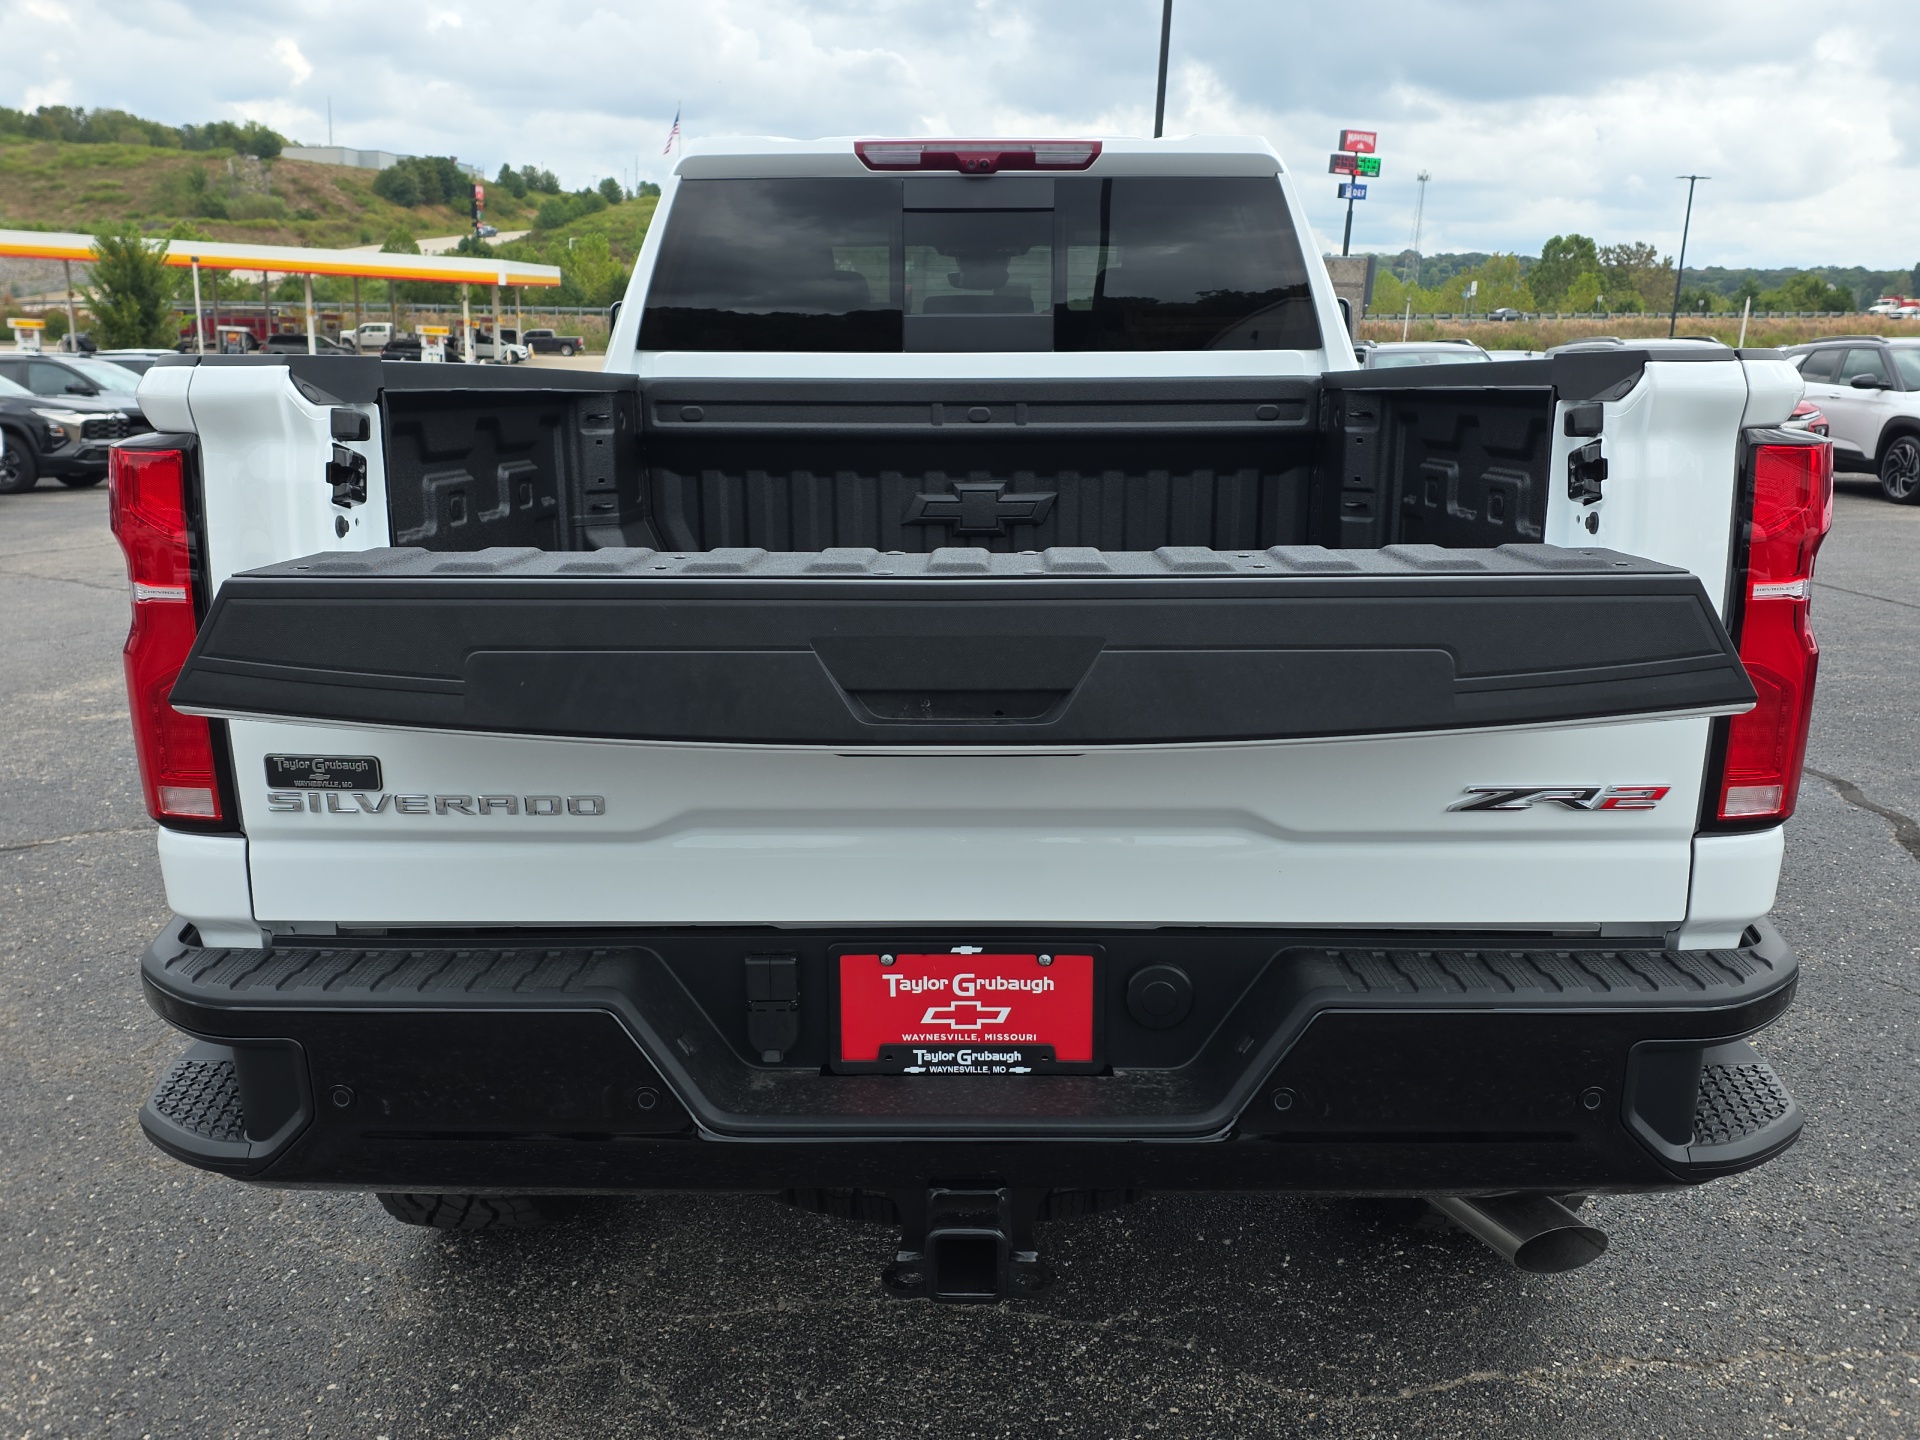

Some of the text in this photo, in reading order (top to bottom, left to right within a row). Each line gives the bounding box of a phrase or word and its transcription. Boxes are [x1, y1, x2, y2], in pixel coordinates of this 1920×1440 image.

[1353, 188, 1365, 197] DEF
[273, 757, 368, 773] Taylor Grubaugh
[294, 780, 341, 788] WAYNESVILLE,
[267, 792, 606, 816] SILVERADO
[1447, 784, 1672, 812] ZR2
[882, 973, 1055, 997] Taylor Grubaugh
[902, 1033, 1037, 1042] WAYNESVILLE, MISSOURI
[913, 1049, 1022, 1065] Taylor Grubaugh
[929, 1066, 990, 1074] WAYNESVILLE,
